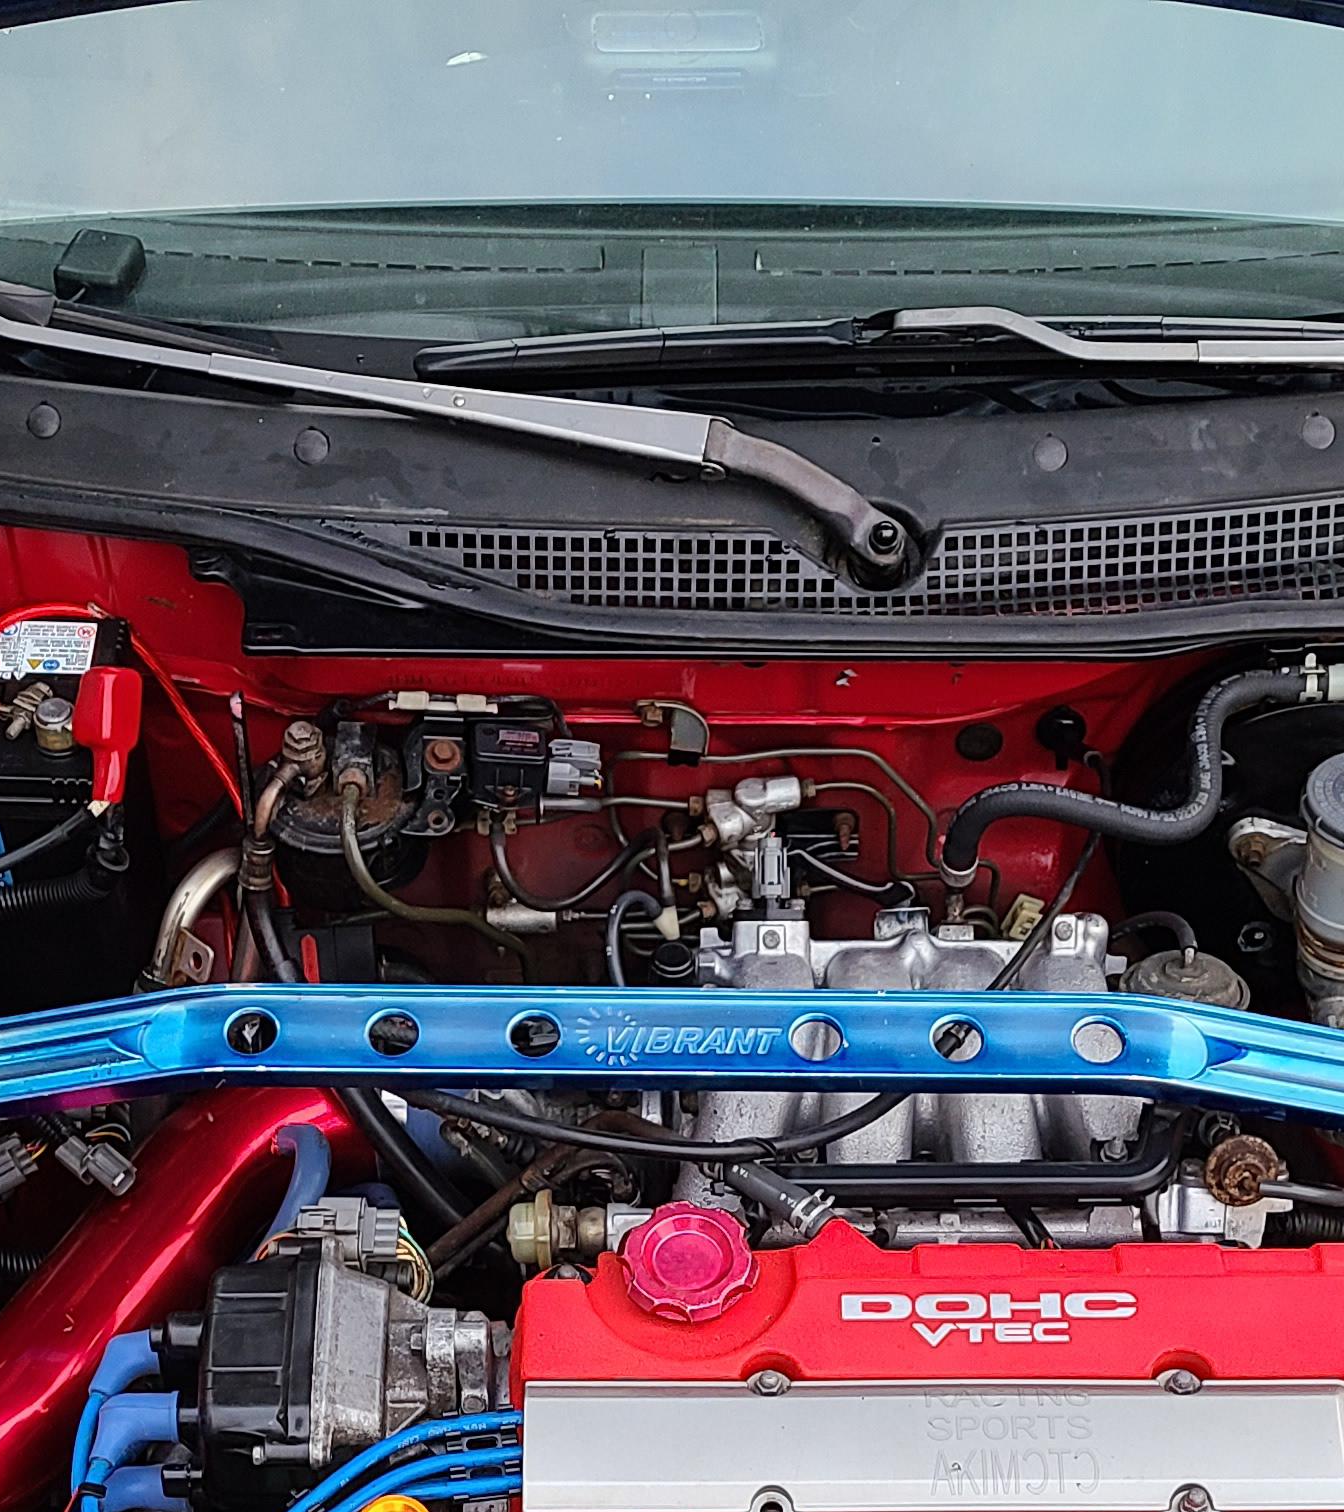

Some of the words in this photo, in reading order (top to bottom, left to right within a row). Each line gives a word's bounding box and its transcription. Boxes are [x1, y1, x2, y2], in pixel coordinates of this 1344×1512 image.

[607, 1027, 782, 1054] VIBRANT
[841, 1292, 1137, 1320] DOHC
[911, 1322, 1070, 1347] VTEC
[923, 1388, 1091, 1408] RACING
[926, 1415, 1092, 1441] SPORTS
